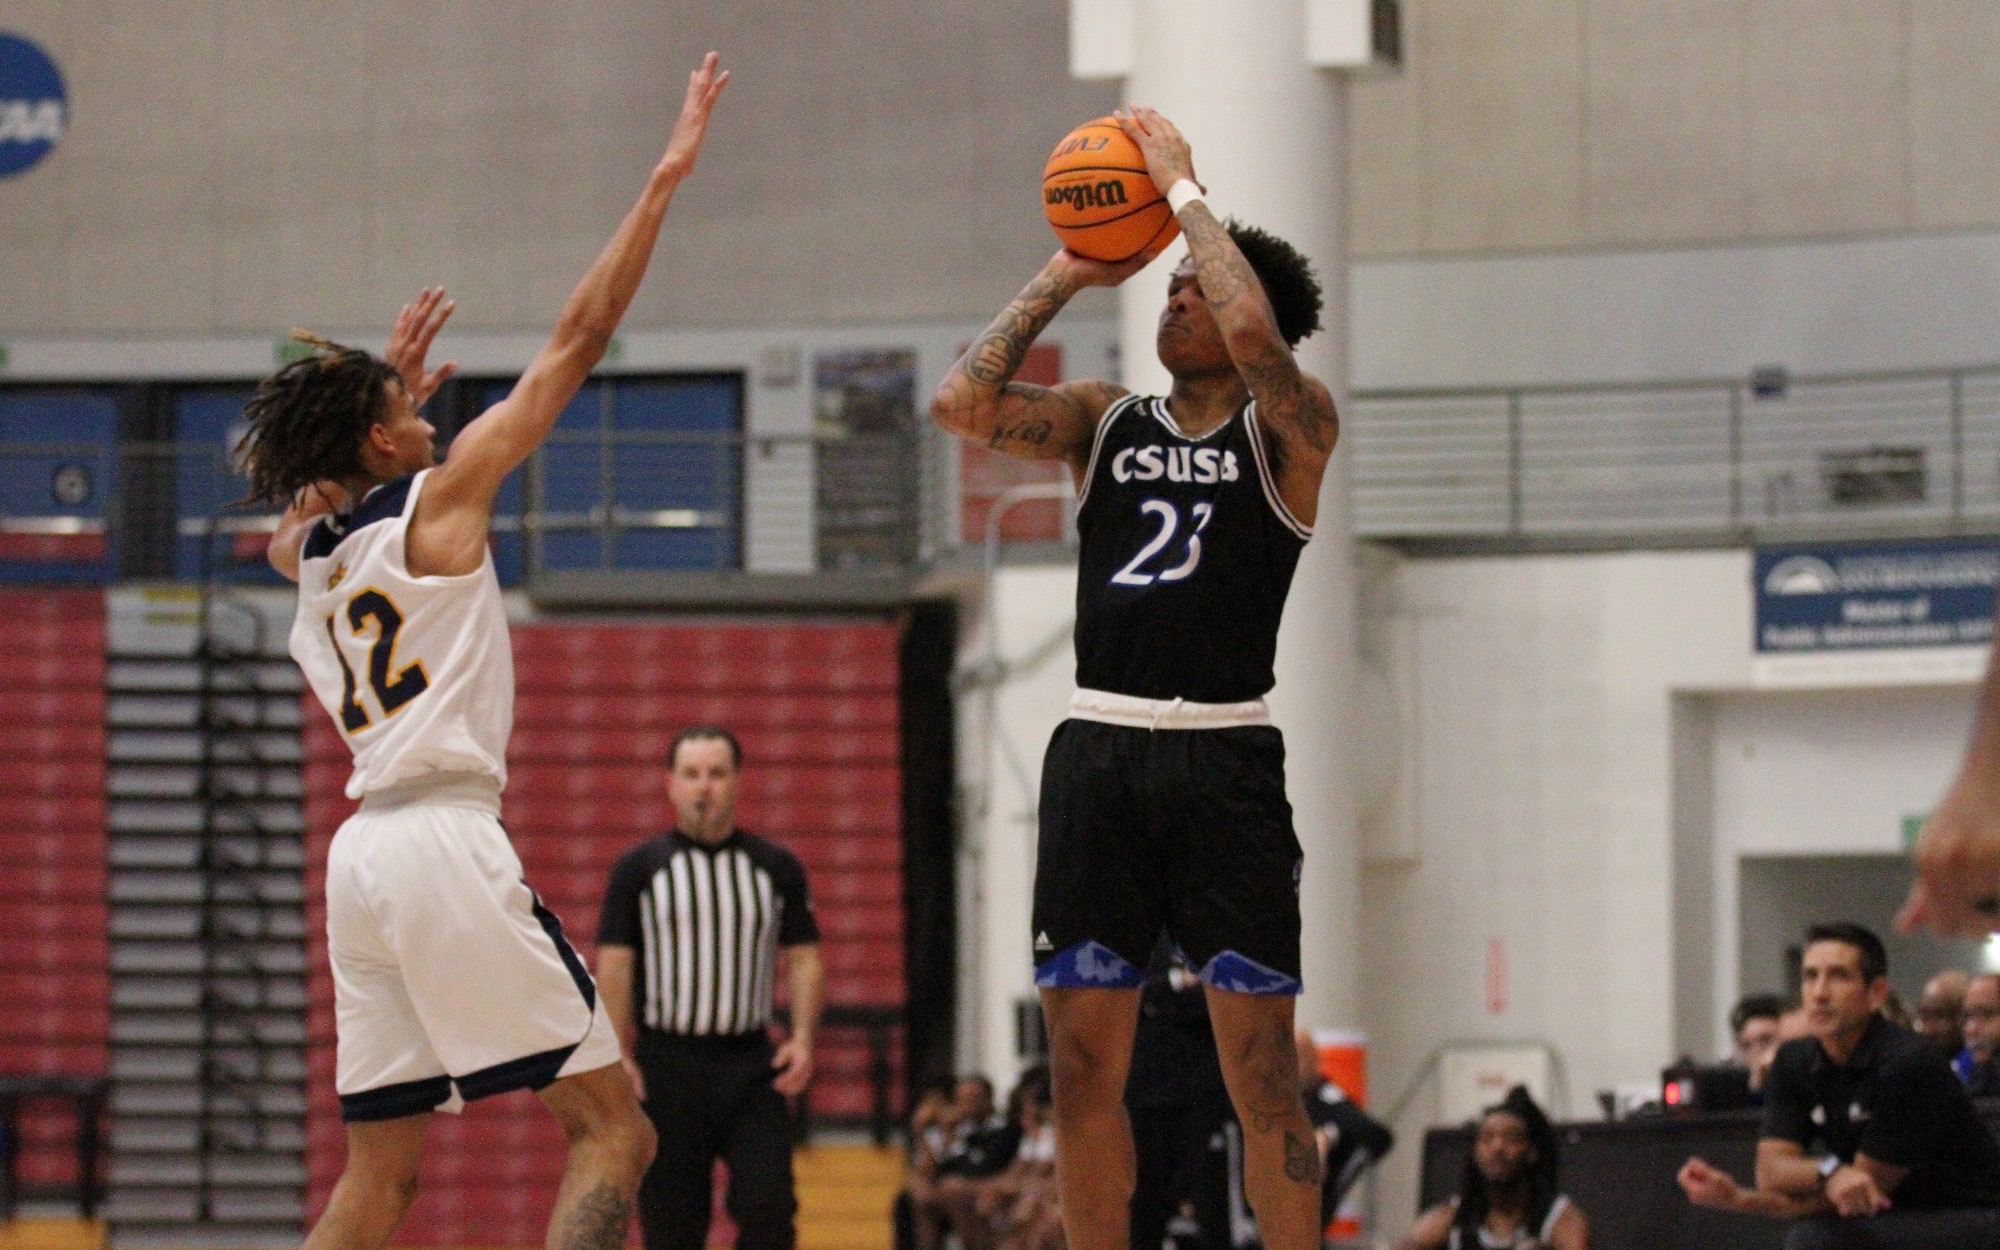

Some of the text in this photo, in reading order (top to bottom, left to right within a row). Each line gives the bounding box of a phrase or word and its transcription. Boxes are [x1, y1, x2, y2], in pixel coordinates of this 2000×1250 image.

[0, 100, 60, 143] AA
[1045, 180, 1130, 211] Wilson
[1111, 445, 1239, 484] CSUSB
[1110, 499, 1213, 585] 23
[326, 585, 431, 736] 12
